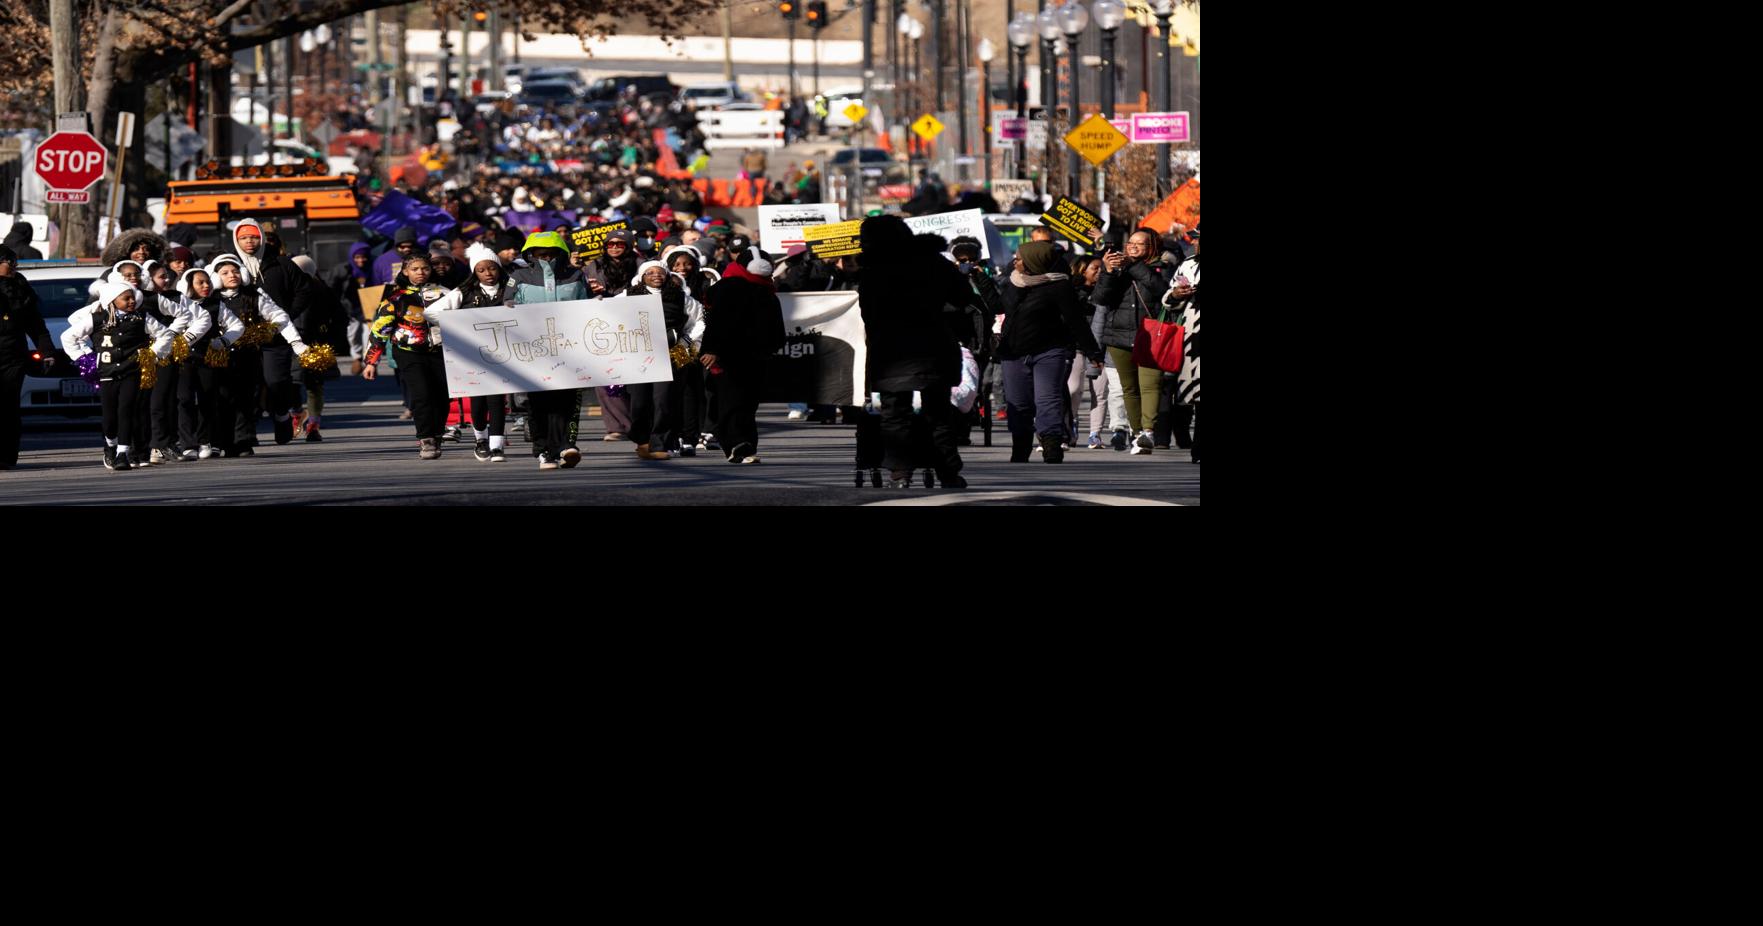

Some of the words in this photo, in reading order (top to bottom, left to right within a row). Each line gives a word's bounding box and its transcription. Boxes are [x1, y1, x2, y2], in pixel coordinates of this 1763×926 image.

[1080, 132, 1114, 140] SPEED
[1081, 142, 1112, 150] HUMP
[39, 149, 102, 173] STOP
[50, 192, 65, 200] ALL
[68, 193, 85, 201] WAY
[1056, 205, 1073, 217] GOT
[1060, 214, 1071, 224] TO
[1069, 221, 1087, 233] LIVE
[572, 222, 627, 240] EVERYBODY'S
[575, 236, 593, 246] GOT
[586, 242, 600, 250] TO
[101, 335, 113, 347] A
[473, 317, 563, 364] Just
[583, 311, 653, 356] Girl
[101, 351, 111, 363] G
